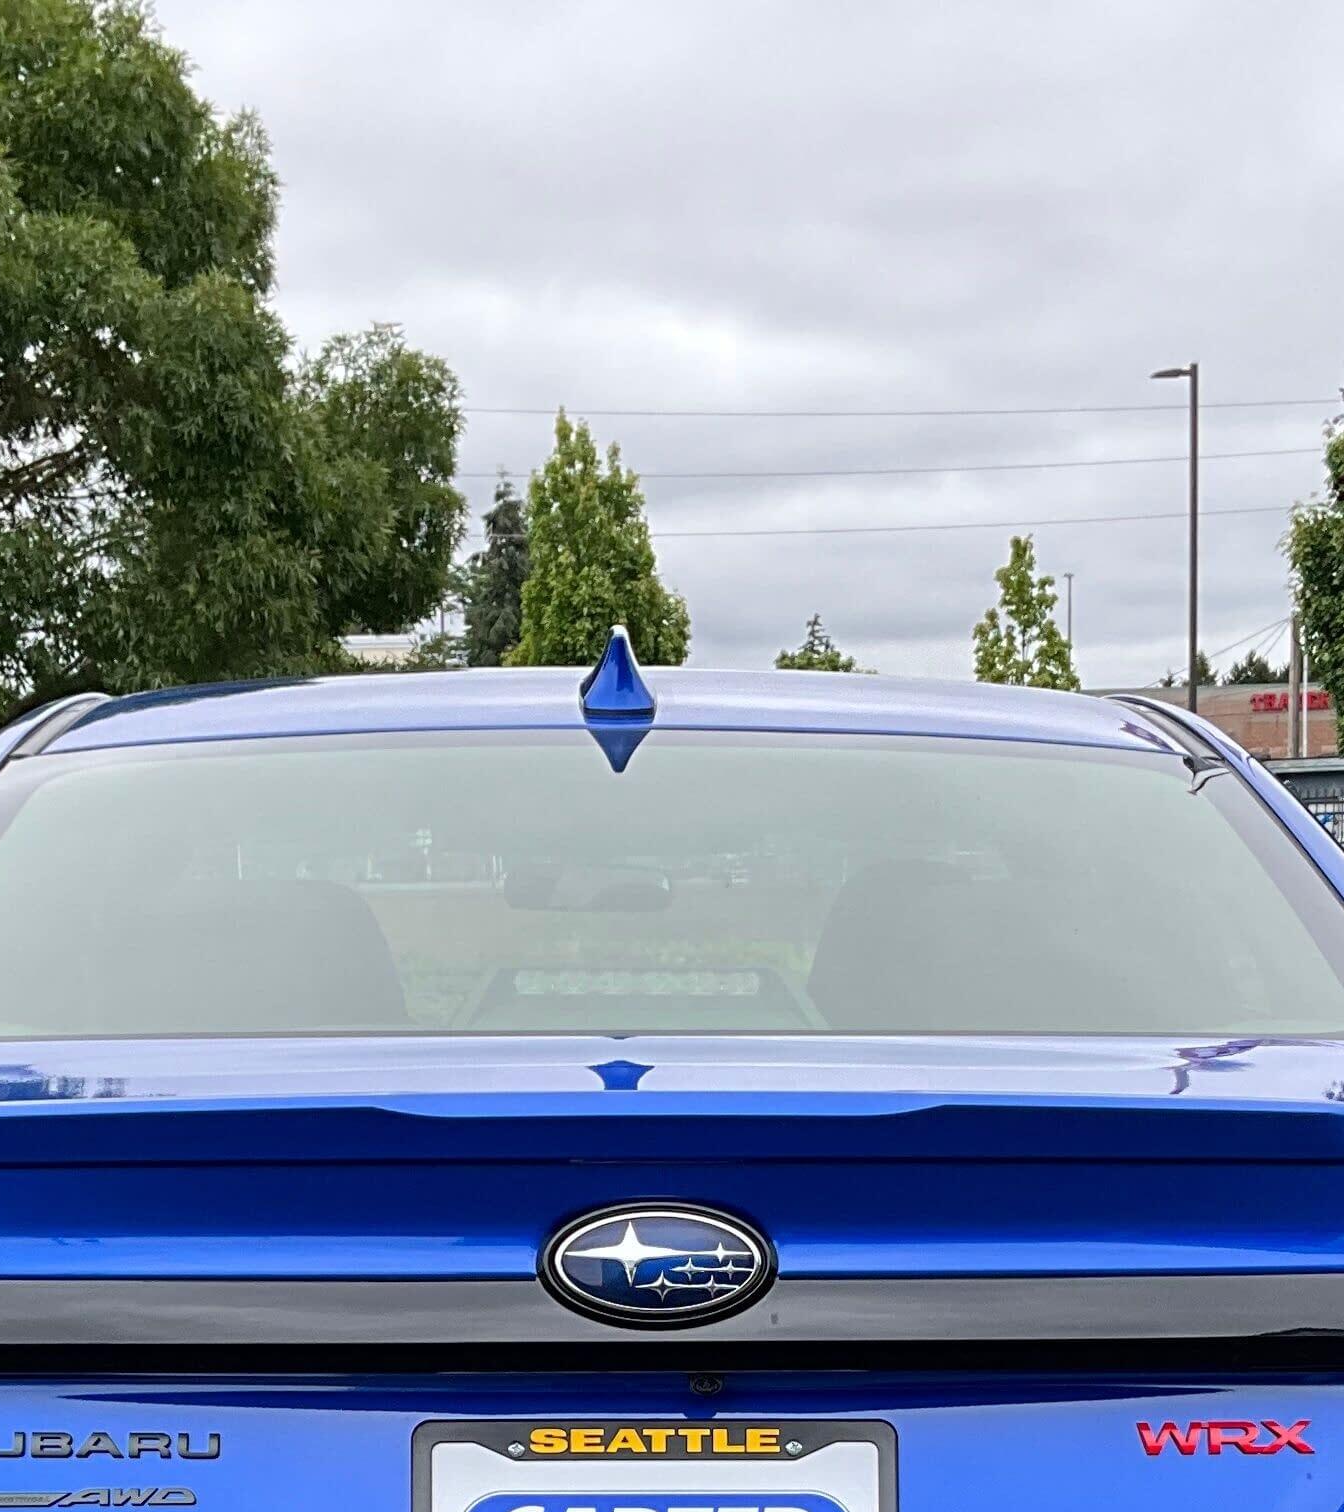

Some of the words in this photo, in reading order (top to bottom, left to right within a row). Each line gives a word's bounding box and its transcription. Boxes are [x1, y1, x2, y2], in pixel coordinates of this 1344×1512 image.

[529, 1427, 781, 1455] SEATTLE
[1135, 1418, 1316, 1456] WRX
[57, 1487, 197, 1507] AWD
